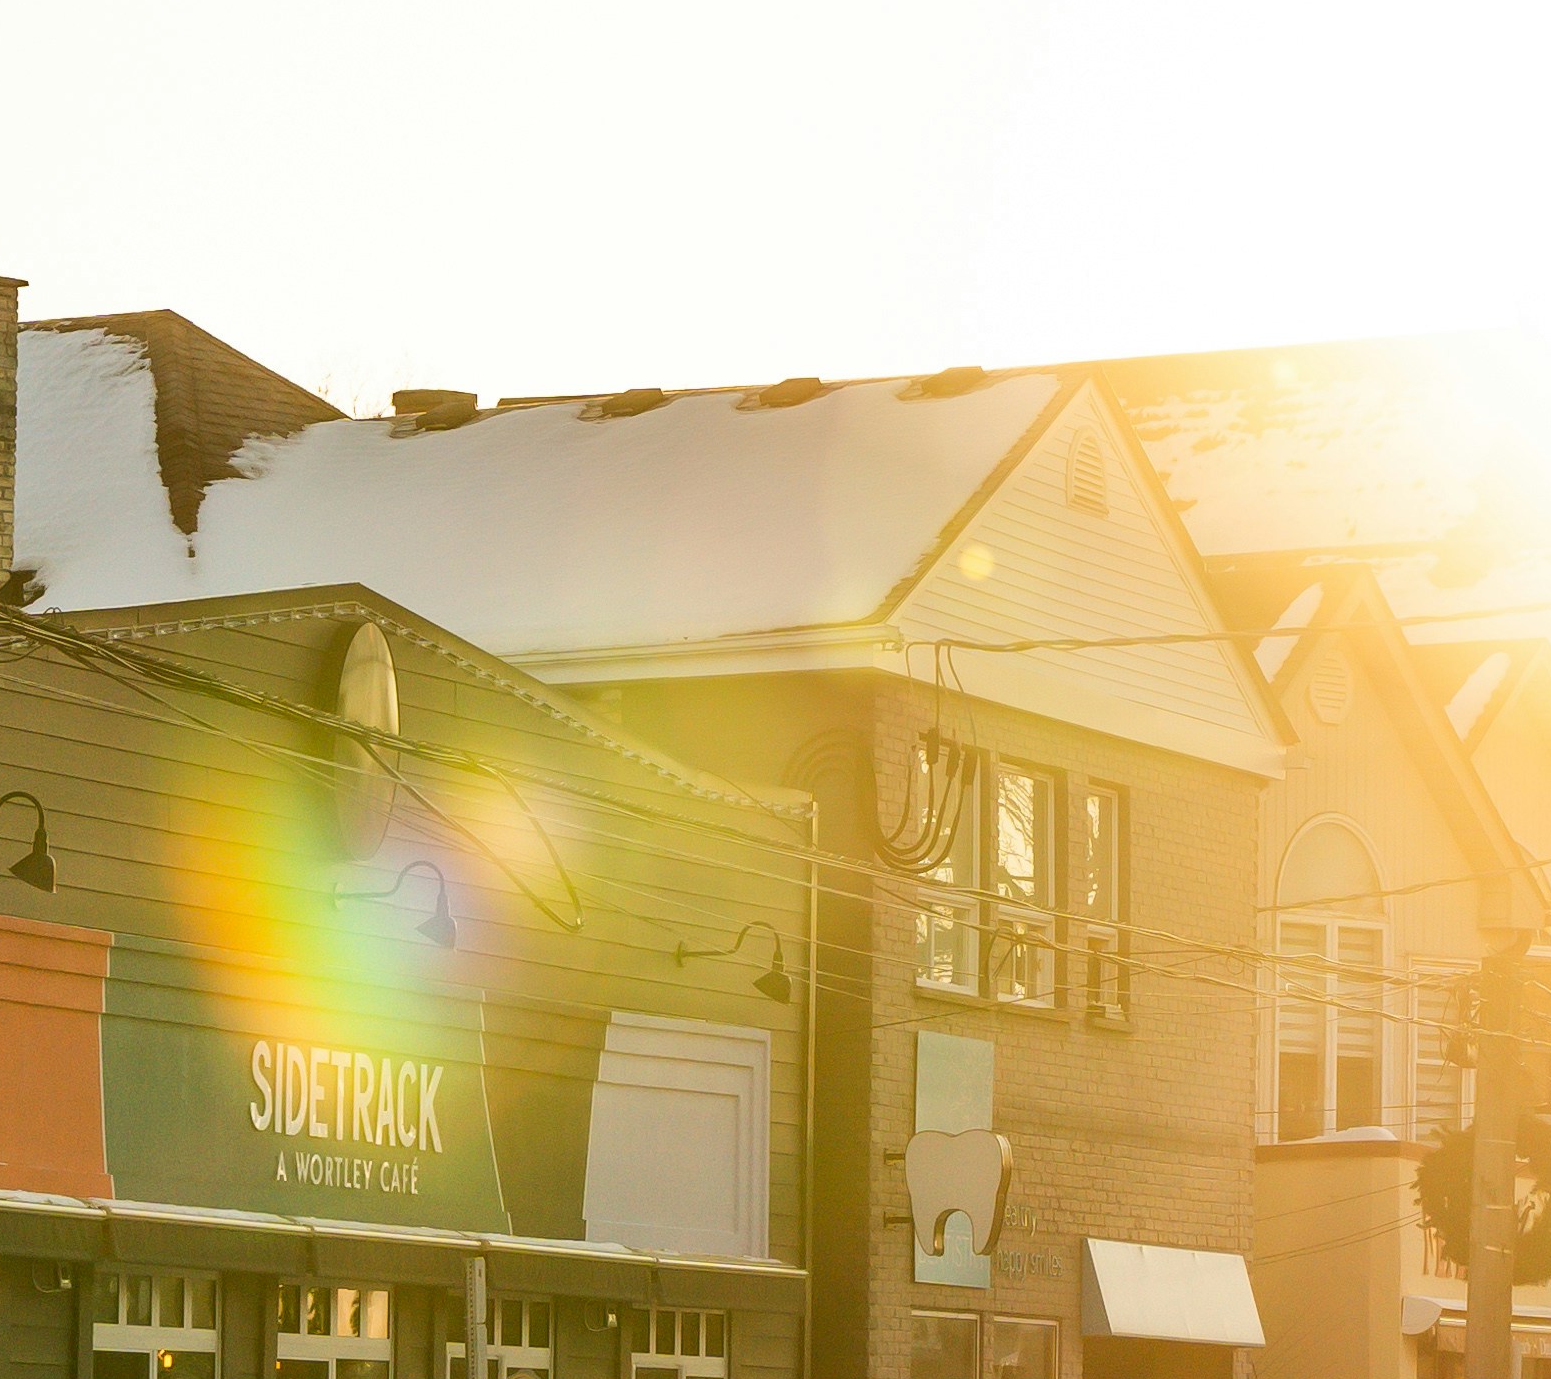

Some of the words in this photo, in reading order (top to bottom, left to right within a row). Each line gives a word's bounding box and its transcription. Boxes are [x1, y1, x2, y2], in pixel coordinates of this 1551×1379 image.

[250, 1040, 444, 1153] SIDETRACK
[276, 1151, 288, 1182] A
[295, 1151, 373, 1190] WORTLEY
[380, 1157, 419, 1195] CAFÉ
